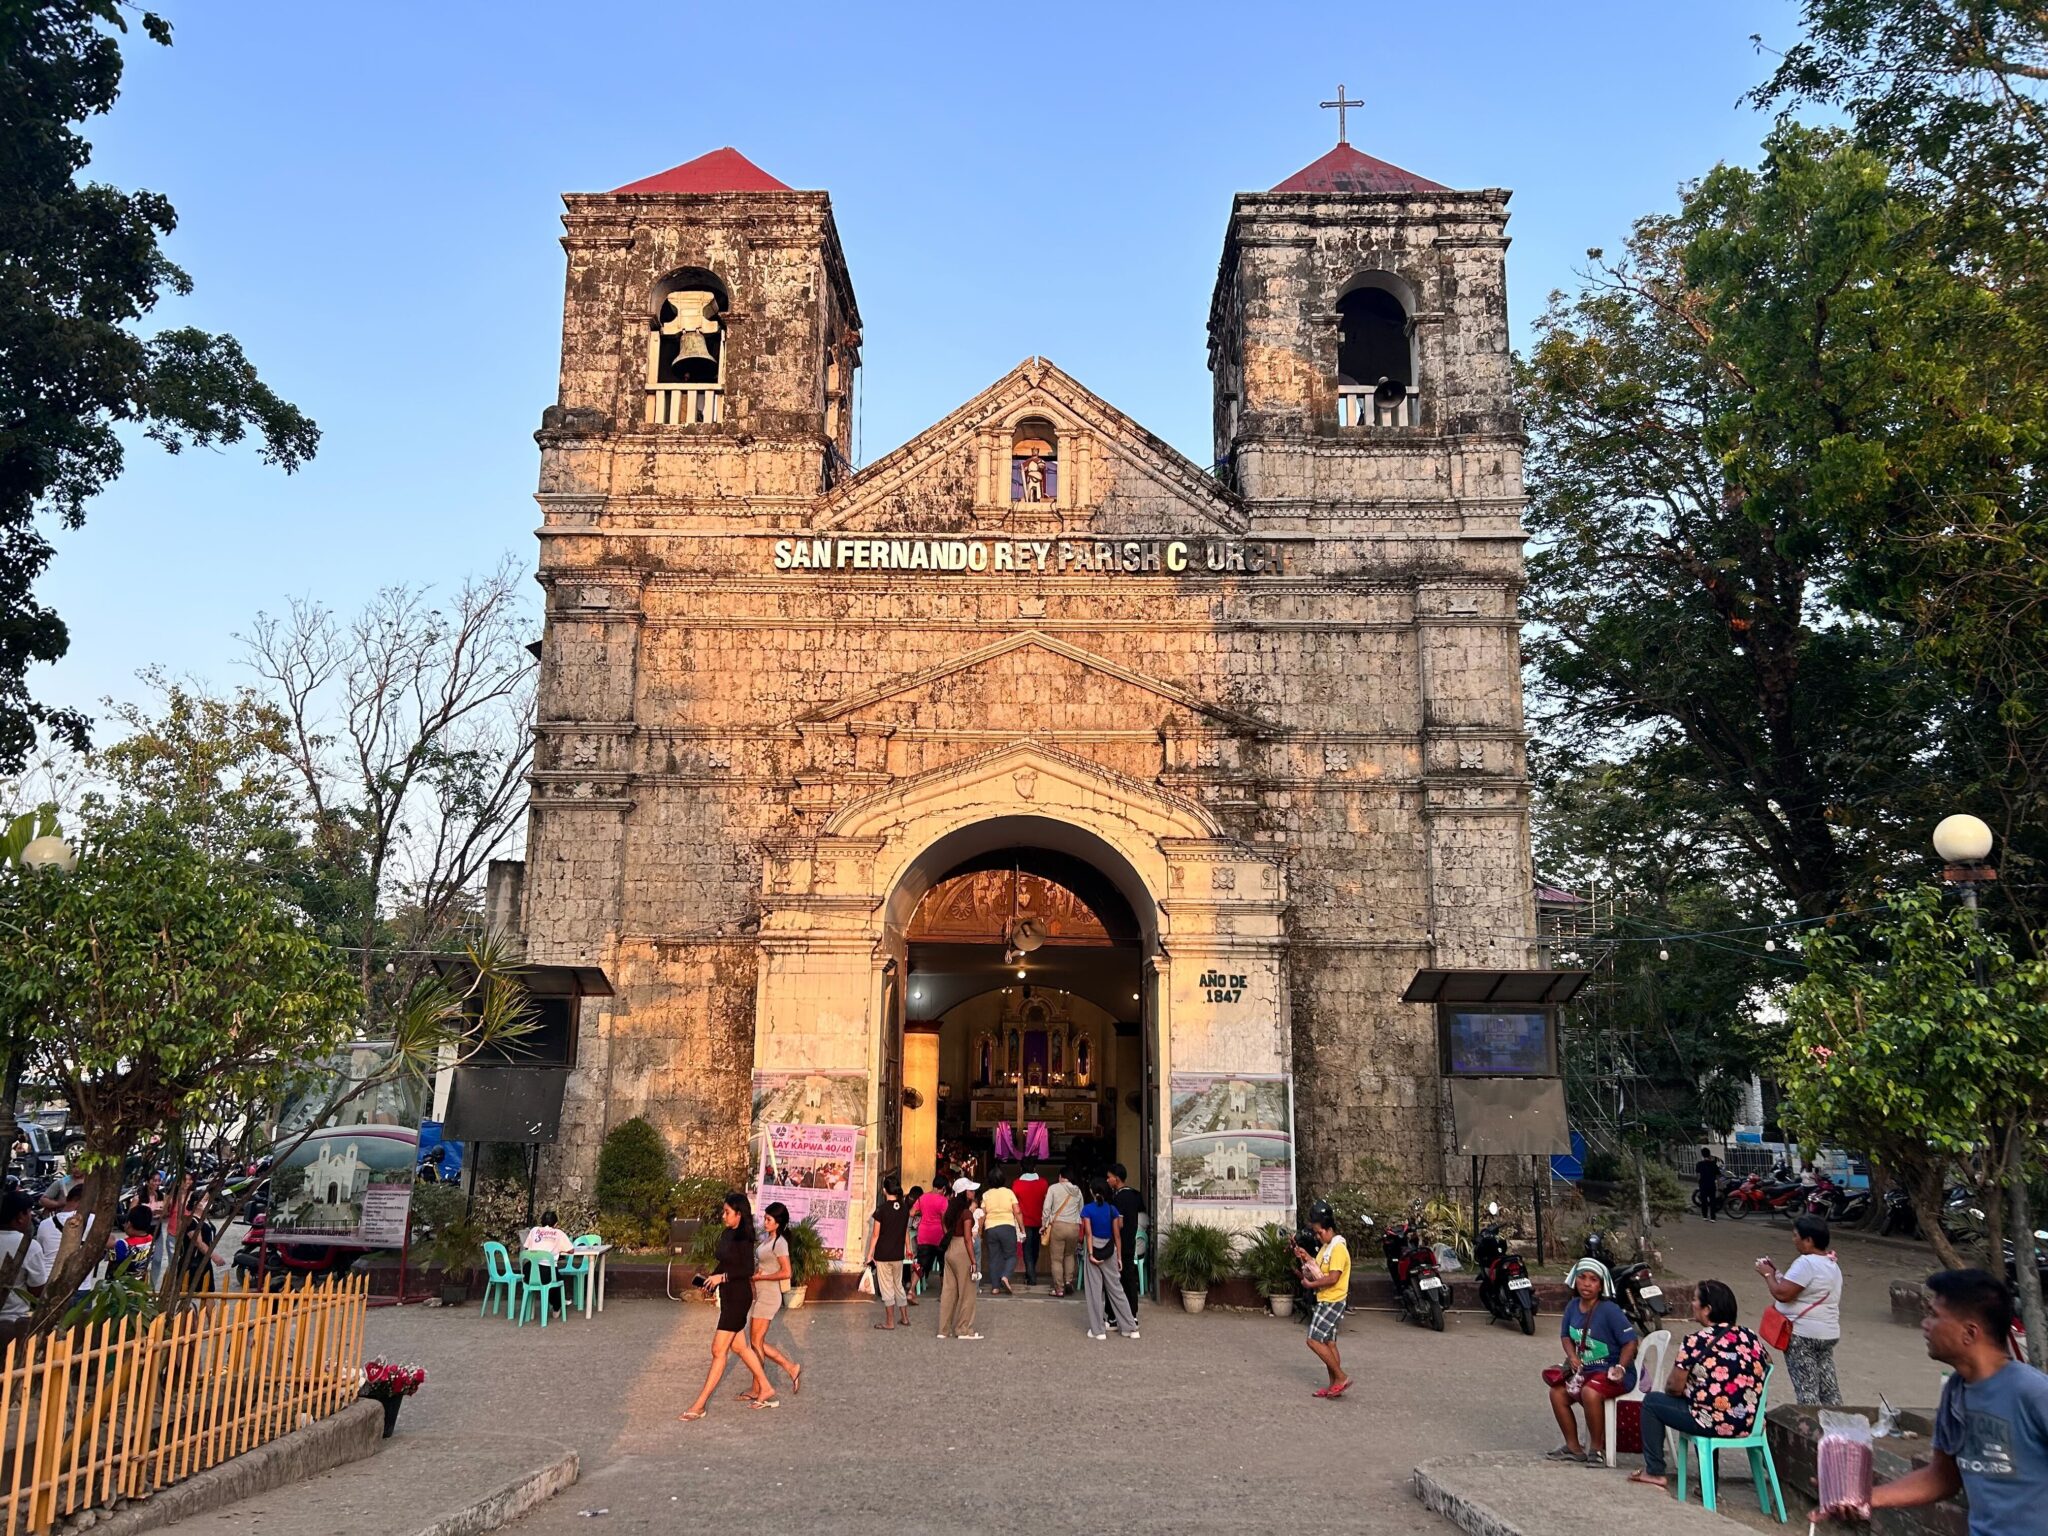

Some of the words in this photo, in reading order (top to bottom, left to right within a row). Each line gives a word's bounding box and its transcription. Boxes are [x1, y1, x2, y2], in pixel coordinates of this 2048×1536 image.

[774, 540, 832, 570] SAN
[836, 541, 988, 571] FERNANDO
[995, 541, 1050, 571] REY
[1058, 541, 1161, 571] PARISH
[1199, 969, 1226, 988] AÑO
[1230, 975, 1248, 989] DE
[1206, 989, 1242, 1004] 1847
[767, 1140, 790, 1149] LAY
[791, 1141, 823, 1152] KAPWA
[825, 1144, 852, 1154] 40/40
